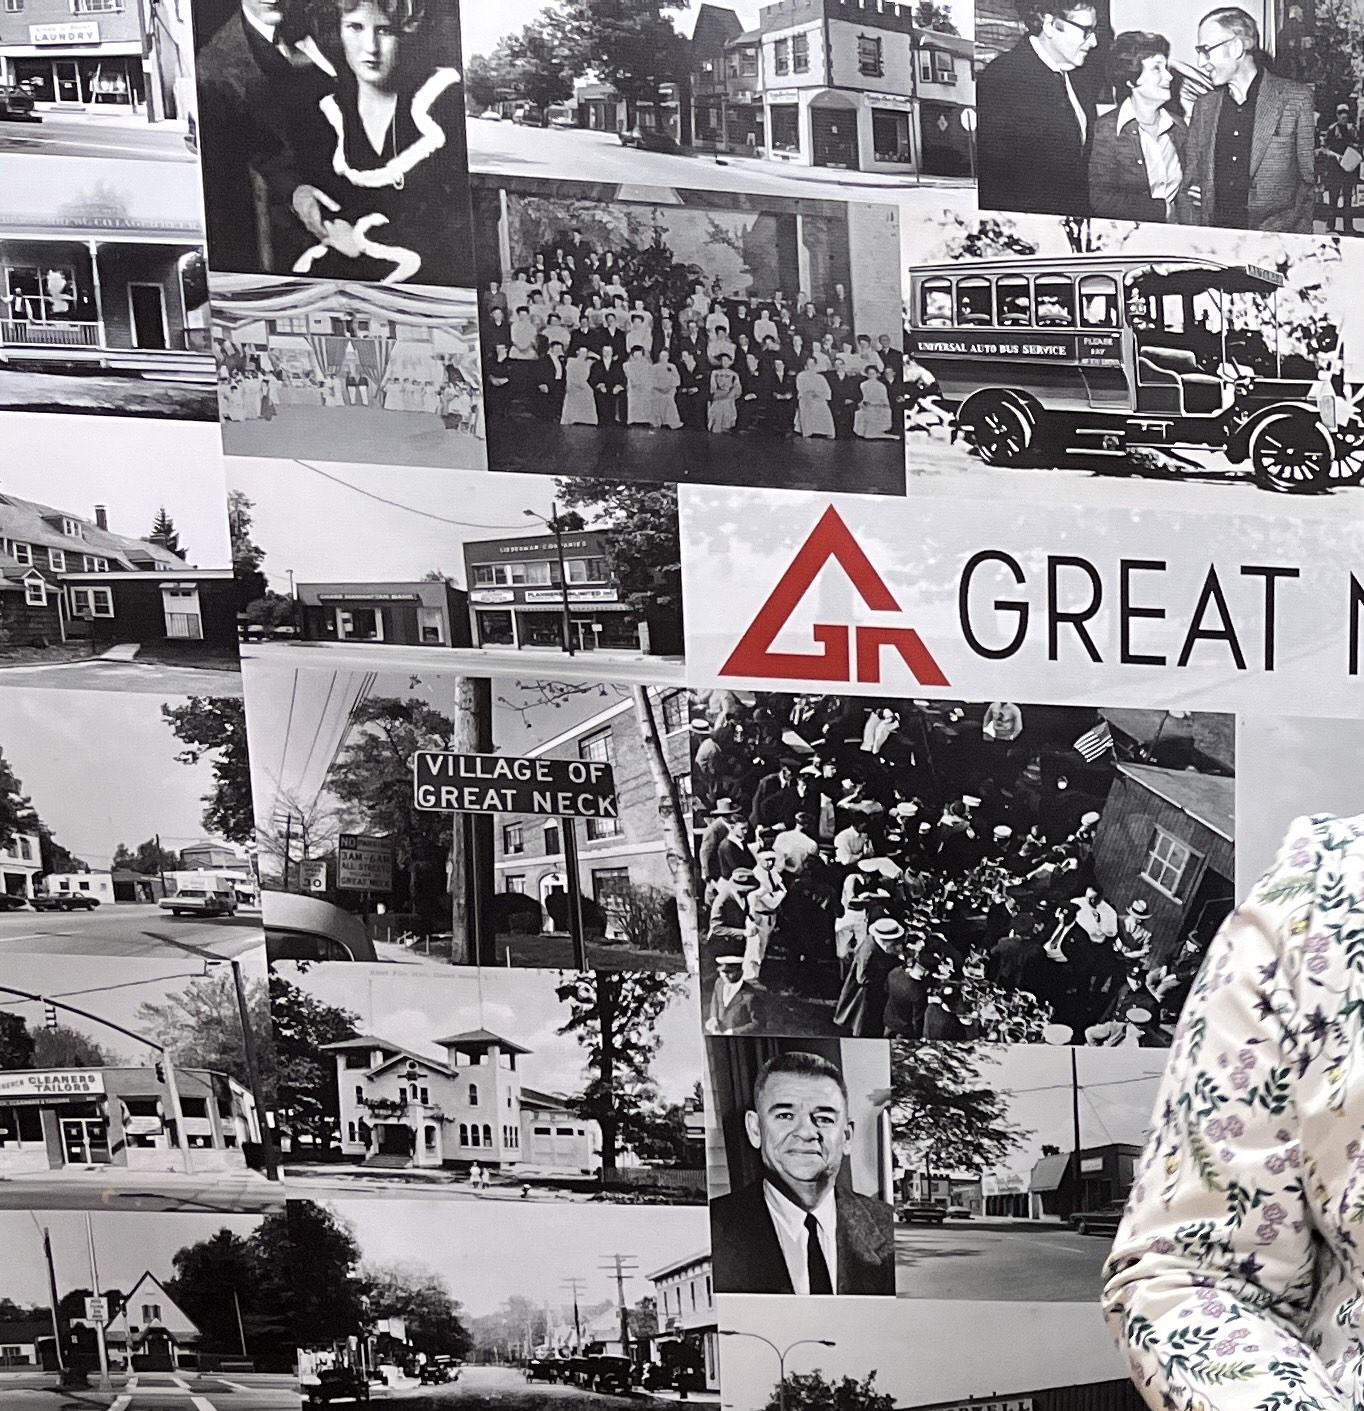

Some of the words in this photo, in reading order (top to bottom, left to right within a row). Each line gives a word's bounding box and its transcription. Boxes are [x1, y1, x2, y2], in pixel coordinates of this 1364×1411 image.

[35, 31, 94, 42] LAUNDRY
[917, 341, 967, 353] UNIVERSAL
[969, 343, 997, 354] AUTO
[999, 344, 1019, 354] BUS
[1022, 345, 1067, 356] SERVICE
[542, 541, 587, 550] COMANIES
[959, 549, 1300, 671] GREAT
[425, 754, 553, 782] VILLAGE
[568, 762, 605, 784] OF
[418, 785, 517, 811] GREAT
[532, 791, 618, 817] NECK
[341, 836, 357, 847] NO
[28, 1074, 96, 1086] CLEANERS
[34, 1083, 90, 1093] TAILORS
